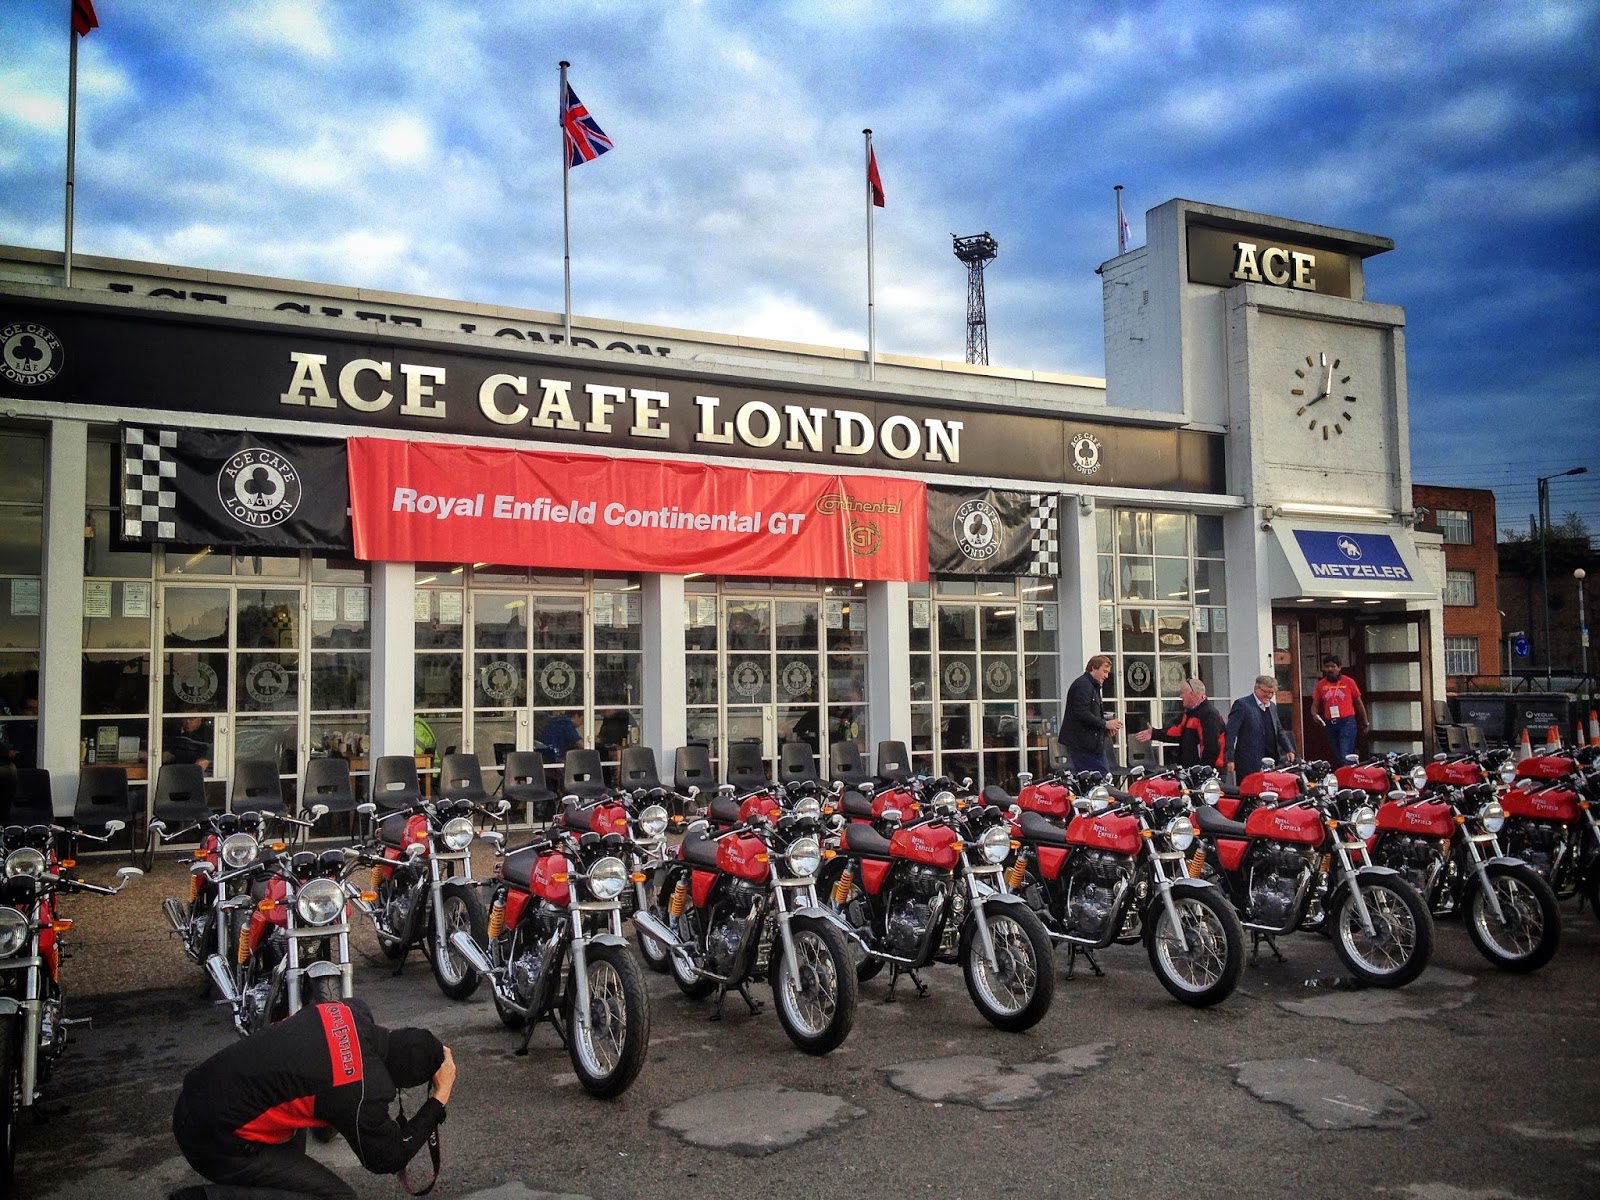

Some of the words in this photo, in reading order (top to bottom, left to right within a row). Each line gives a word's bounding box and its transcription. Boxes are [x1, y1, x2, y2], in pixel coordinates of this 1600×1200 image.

[1232, 242, 1316, 291] ACE
[0, 324, 22, 343] ACE
[26, 324, 60, 349] CAFE
[0, 362, 56, 384] LONDON
[280, 351, 446, 419] ACE
[478, 373, 671, 440] CAFE
[695, 395, 964, 464] LONDON
[1070, 433, 1083, 448] ACE
[1083, 432, 1102, 449] CAFE
[225, 452, 254, 479] ACE
[259, 452, 296, 483] CAFE
[1072, 461, 1101, 475] LONDON
[226, 497, 293, 524] LONDON
[392, 486, 483, 521] Royal
[493, 494, 597, 525] Enfield
[603, 501, 761, 533] Continental
[766, 513, 806, 536] GT
[816, 493, 903, 516] Continental
[957, 503, 974, 523] ACE
[976, 502, 999, 526] CAFE
[851, 525, 876, 547] GT
[959, 537, 999, 558] LONDON
[1311, 562, 1408, 579] METZELER
[1279, 823, 1301, 832] ENFIELD
[1410, 818, 1433, 826] ENFIELD
[1097, 830, 1119, 839] ENFIELD
[331, 1025, 356, 1077] ENFIELD
